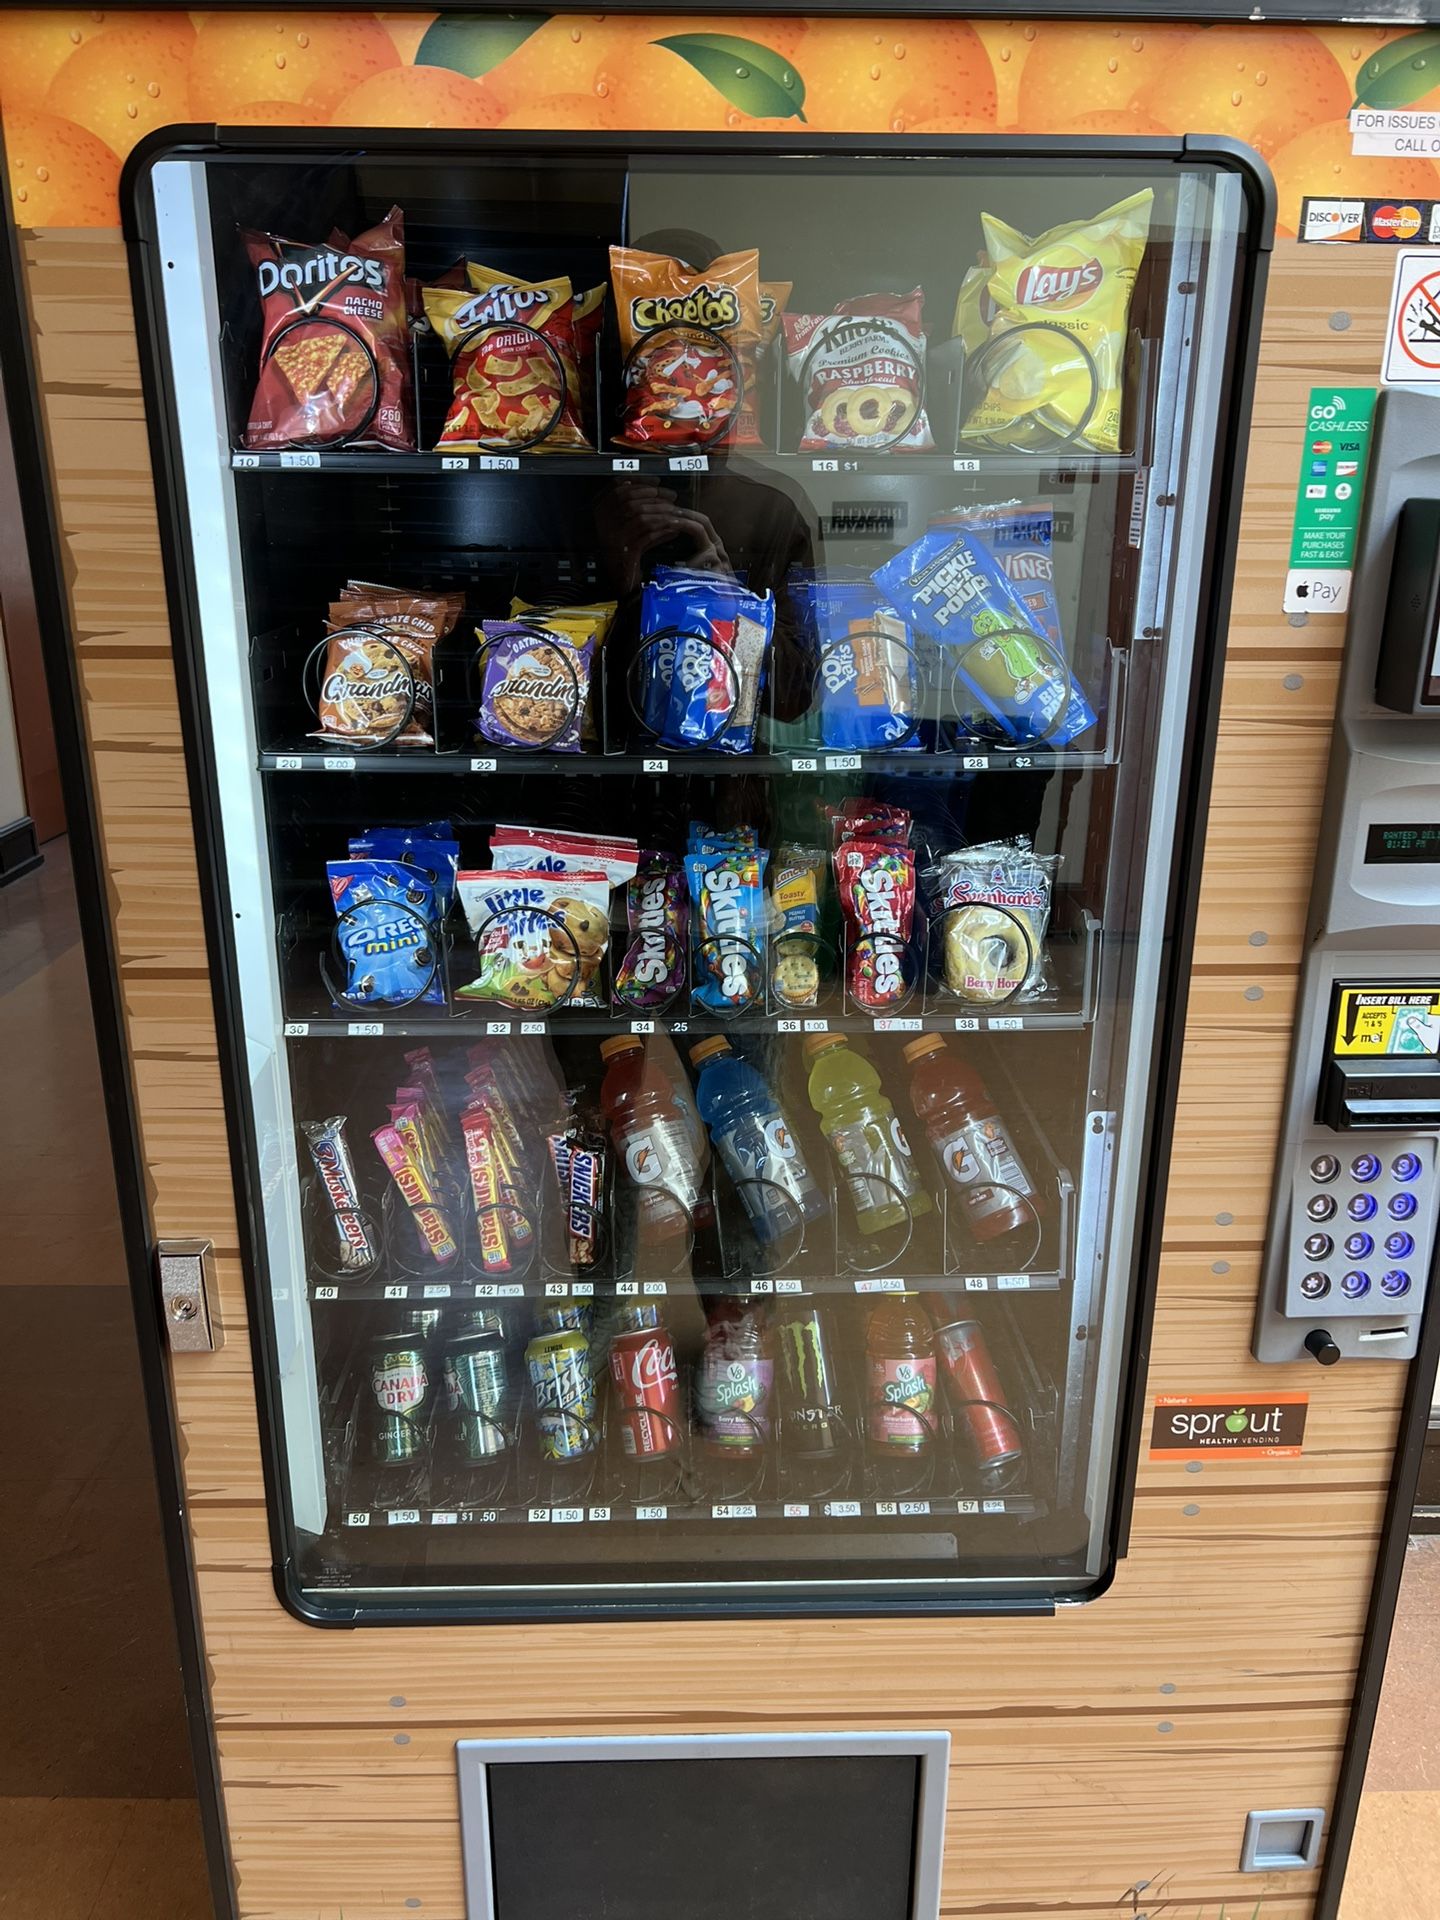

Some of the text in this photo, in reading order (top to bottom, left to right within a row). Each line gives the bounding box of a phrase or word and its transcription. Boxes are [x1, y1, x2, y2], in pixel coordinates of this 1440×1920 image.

[1356, 114, 1435, 129] FOR ISSUES
[1395, 138, 1427, 151] CALL
[258, 252, 383, 296] Doritos
[1023, 264, 1098, 305] Lay's
[345, 296, 383, 310] NACHO
[453, 284, 549, 329] Fritos
[633, 285, 737, 328] Cheetos
[343, 305, 384, 319] CHEESE
[818, 344, 910, 367] Premium Cookies
[816, 360, 916, 384] RASPBERRY
[381, 409, 401, 422] 260
[1311, 405, 1336, 419] GO
[1309, 421, 1369, 432] CASHLESS
[1339, 443, 1360, 451] VISA
[239, 458, 254, 467] 10
[289, 455, 315, 467] 1.50
[448, 460, 464, 469] 12
[487, 459, 513, 470] 1.50
[618, 461, 634, 469] 14
[677, 458, 702, 471] 1.50
[818, 461, 834, 471] 16
[843, 460, 859, 471] $1
[959, 461, 976, 470] 18
[1303, 532, 1346, 540] MAKE YOUR
[1302, 541, 1345, 549] PURCHASES
[1300, 551, 1318, 559] FAST
[1325, 551, 1344, 559] EASY
[917, 550, 977, 605] PICKLE
[1312, 581, 1342, 603] Pay
[411, 616, 436, 632] CHIP
[839, 643, 859, 682] tarts
[281, 759, 297, 769] 20
[327, 760, 348, 769] 2.00
[476, 761, 492, 770] 22
[648, 761, 663, 770] 24
[797, 760, 812, 770] 26
[832, 757, 856, 768] 1.50
[968, 757, 984, 768] 28
[1015, 757, 1032, 767] $2
[779, 891, 806, 900] Toasty
[634, 878, 669, 984] Skittles
[704, 871, 750, 997] Skittles
[860, 869, 904, 995] Skittles
[366, 931, 420, 954] mini
[1355, 994, 1432, 1005] INSERT BILL HERE
[1361, 1012, 1387, 1020] ACCEPTS
[355, 1024, 378, 1035] 1.50
[491, 1023, 506, 1033] 32
[523, 1024, 542, 1033] 2.50
[636, 1023, 650, 1031] 34
[670, 1023, 688, 1032] .25
[782, 1022, 796, 1031] 36
[807, 1022, 825, 1030] 1.00
[879, 1020, 893, 1029] 37
[901, 1019, 920, 1029] 1.75
[960, 1020, 974, 1029] 38
[289, 1025, 304, 1035] 30
[626, 1135, 663, 1183] G
[943, 1136, 981, 1183] G
[1317, 1161, 1326, 1173] 1
[1357, 1160, 1369, 1173] 2
[1398, 1160, 1409, 1172] 3
[313, 1143, 369, 1249] 3 Muskeeers
[1313, 1200, 1325, 1212] 4
[1354, 1199, 1365, 1212] 5
[1393, 1199, 1404, 1211] 6
[1310, 1239, 1322, 1251] 7
[1350, 1238, 1362, 1250] 8
[1389, 1237, 1401, 1250] 9
[620, 1283, 634, 1293] 44
[645, 1283, 664, 1292] 2.00
[754, 1281, 769, 1291] 46
[778, 1281, 796, 1290] 2.50
[861, 1283, 873, 1291] 47
[883, 1281, 900, 1289] 2.50
[969, 1279, 983, 1288] 48
[1346, 1276, 1358, 1289] 0
[319, 1287, 334, 1297] 40
[389, 1287, 403, 1297] 41
[479, 1285, 493, 1295] 42
[549, 1284, 563, 1294] 43
[575, 1284, 592, 1293] 1.50
[544, 1343, 564, 1353] LEMON
[730, 1365, 743, 1379] V8
[899, 1366, 911, 1379] V8
[372, 1371, 429, 1392] CANADA
[535, 1352, 588, 1405] Brisk
[716, 1375, 759, 1405] Splash
[885, 1375, 926, 1414] Splash
[386, 1390, 416, 1405] DRY
[378, 1428, 412, 1440] GINGER
[1200, 1436, 1280, 1445] HEALTHY VENDING
[716, 1506, 729, 1515] 54
[736, 1507, 752, 1515] 2.25
[789, 1506, 802, 1515] 55
[823, 1504, 856, 1516] $ 3.50
[880, 1504, 893, 1513] 56
[904, 1503, 926, 1513] 2.50
[962, 1501, 975, 1511] 57
[394, 1511, 415, 1521] 1.50
[461, 1511, 496, 1522] $1 .50
[533, 1510, 546, 1519] 52
[558, 1510, 578, 1520] 1.50
[593, 1509, 607, 1518] 53
[642, 1508, 662, 1517] 1.50
[352, 1513, 366, 1524] 50
